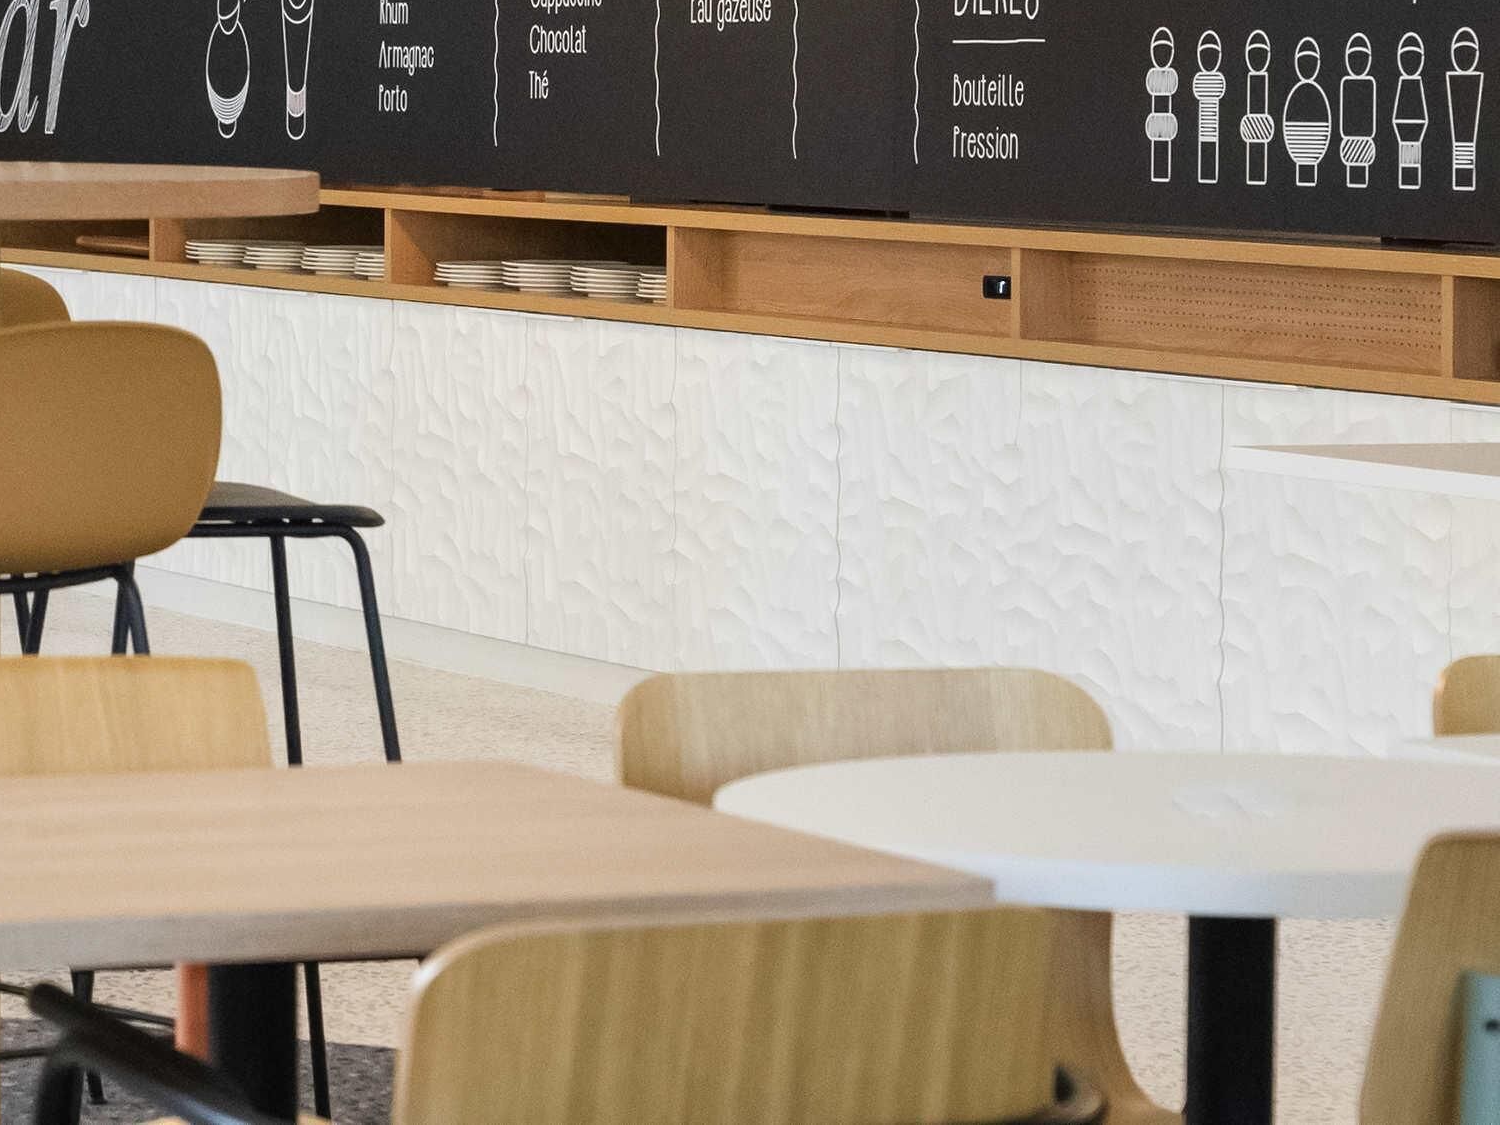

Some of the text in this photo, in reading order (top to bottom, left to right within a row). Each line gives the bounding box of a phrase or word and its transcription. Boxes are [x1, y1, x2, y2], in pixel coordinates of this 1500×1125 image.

[529, 24, 588, 55] Chocolat
[378, 40, 435, 77] Armagnac
[378, 83, 408, 113] Porto
[528, 69, 549, 100] Thé
[952, 73, 1024, 107] Bouteille
[952, 125, 1019, 160] Pression
